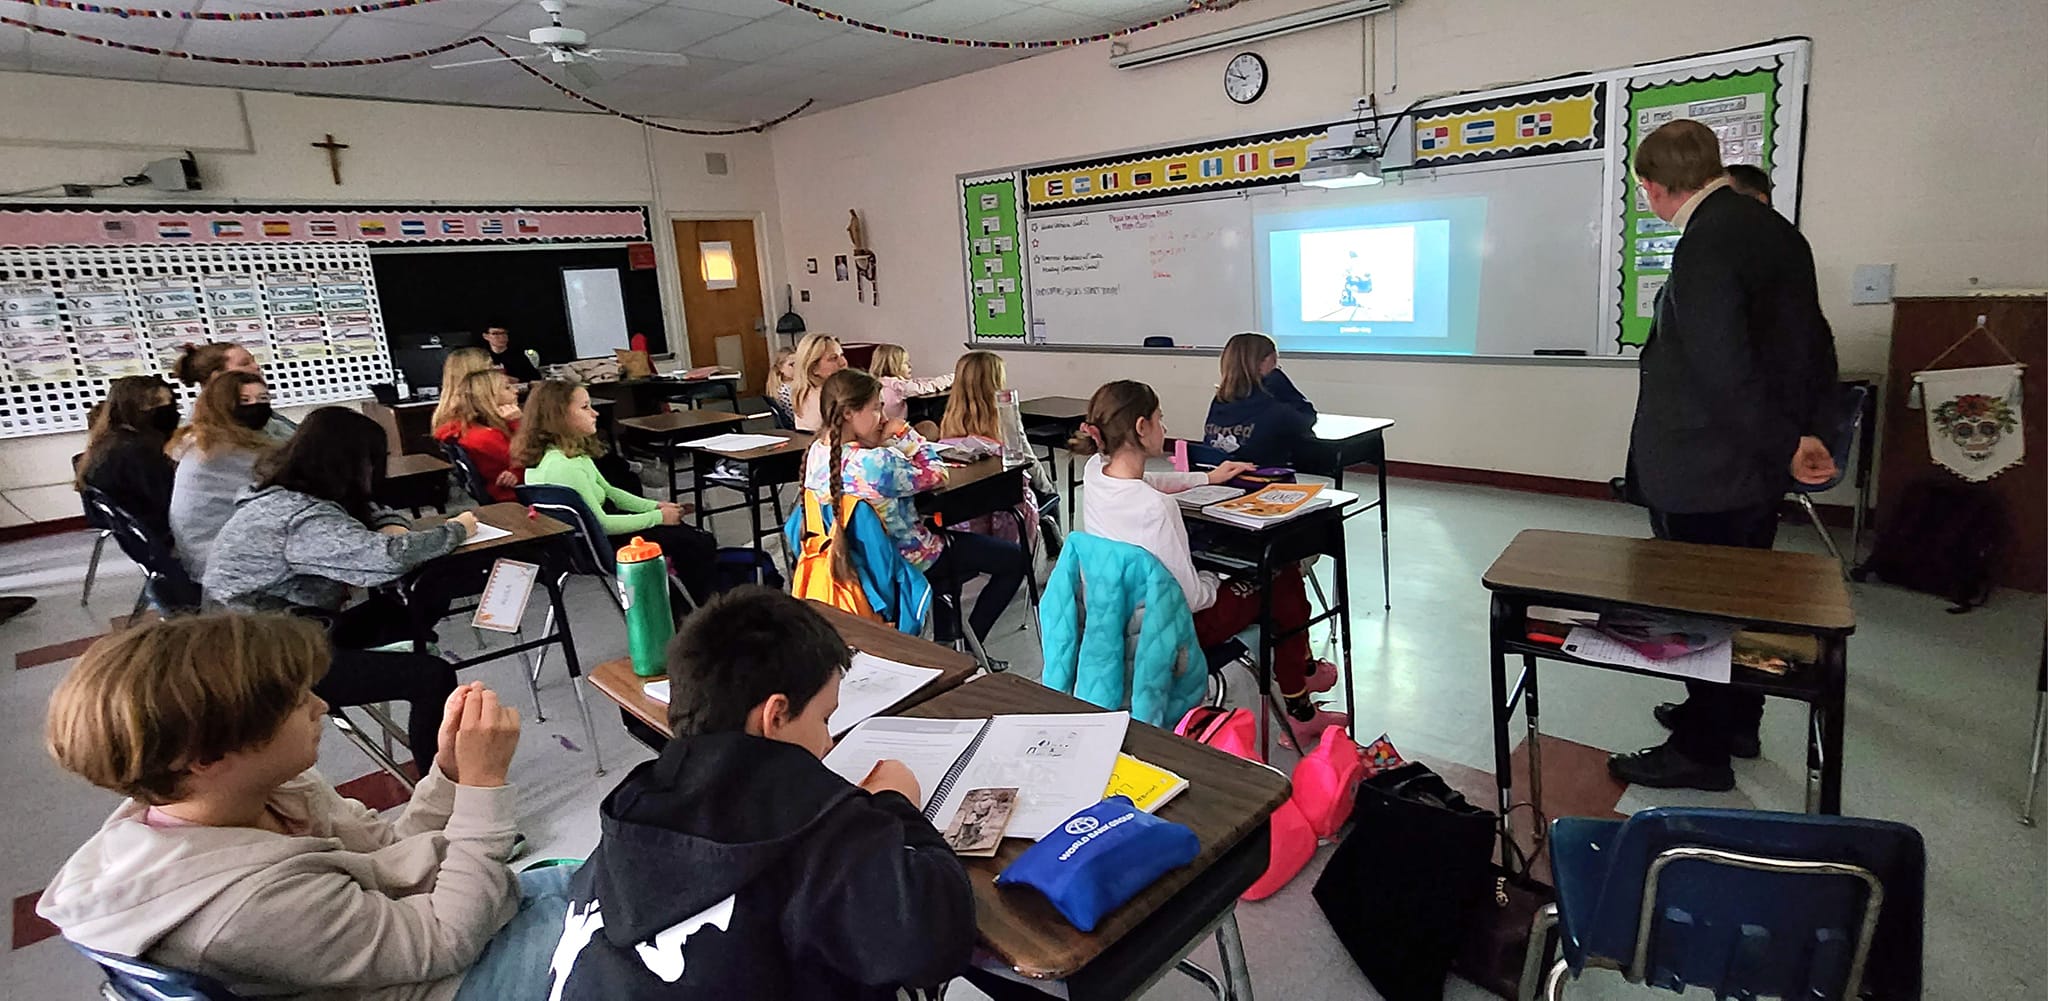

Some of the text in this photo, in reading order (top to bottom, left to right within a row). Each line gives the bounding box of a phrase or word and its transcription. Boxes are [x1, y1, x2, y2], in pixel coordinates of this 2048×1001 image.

[1058, 813, 1135, 861] WORLD BANK GROUP
